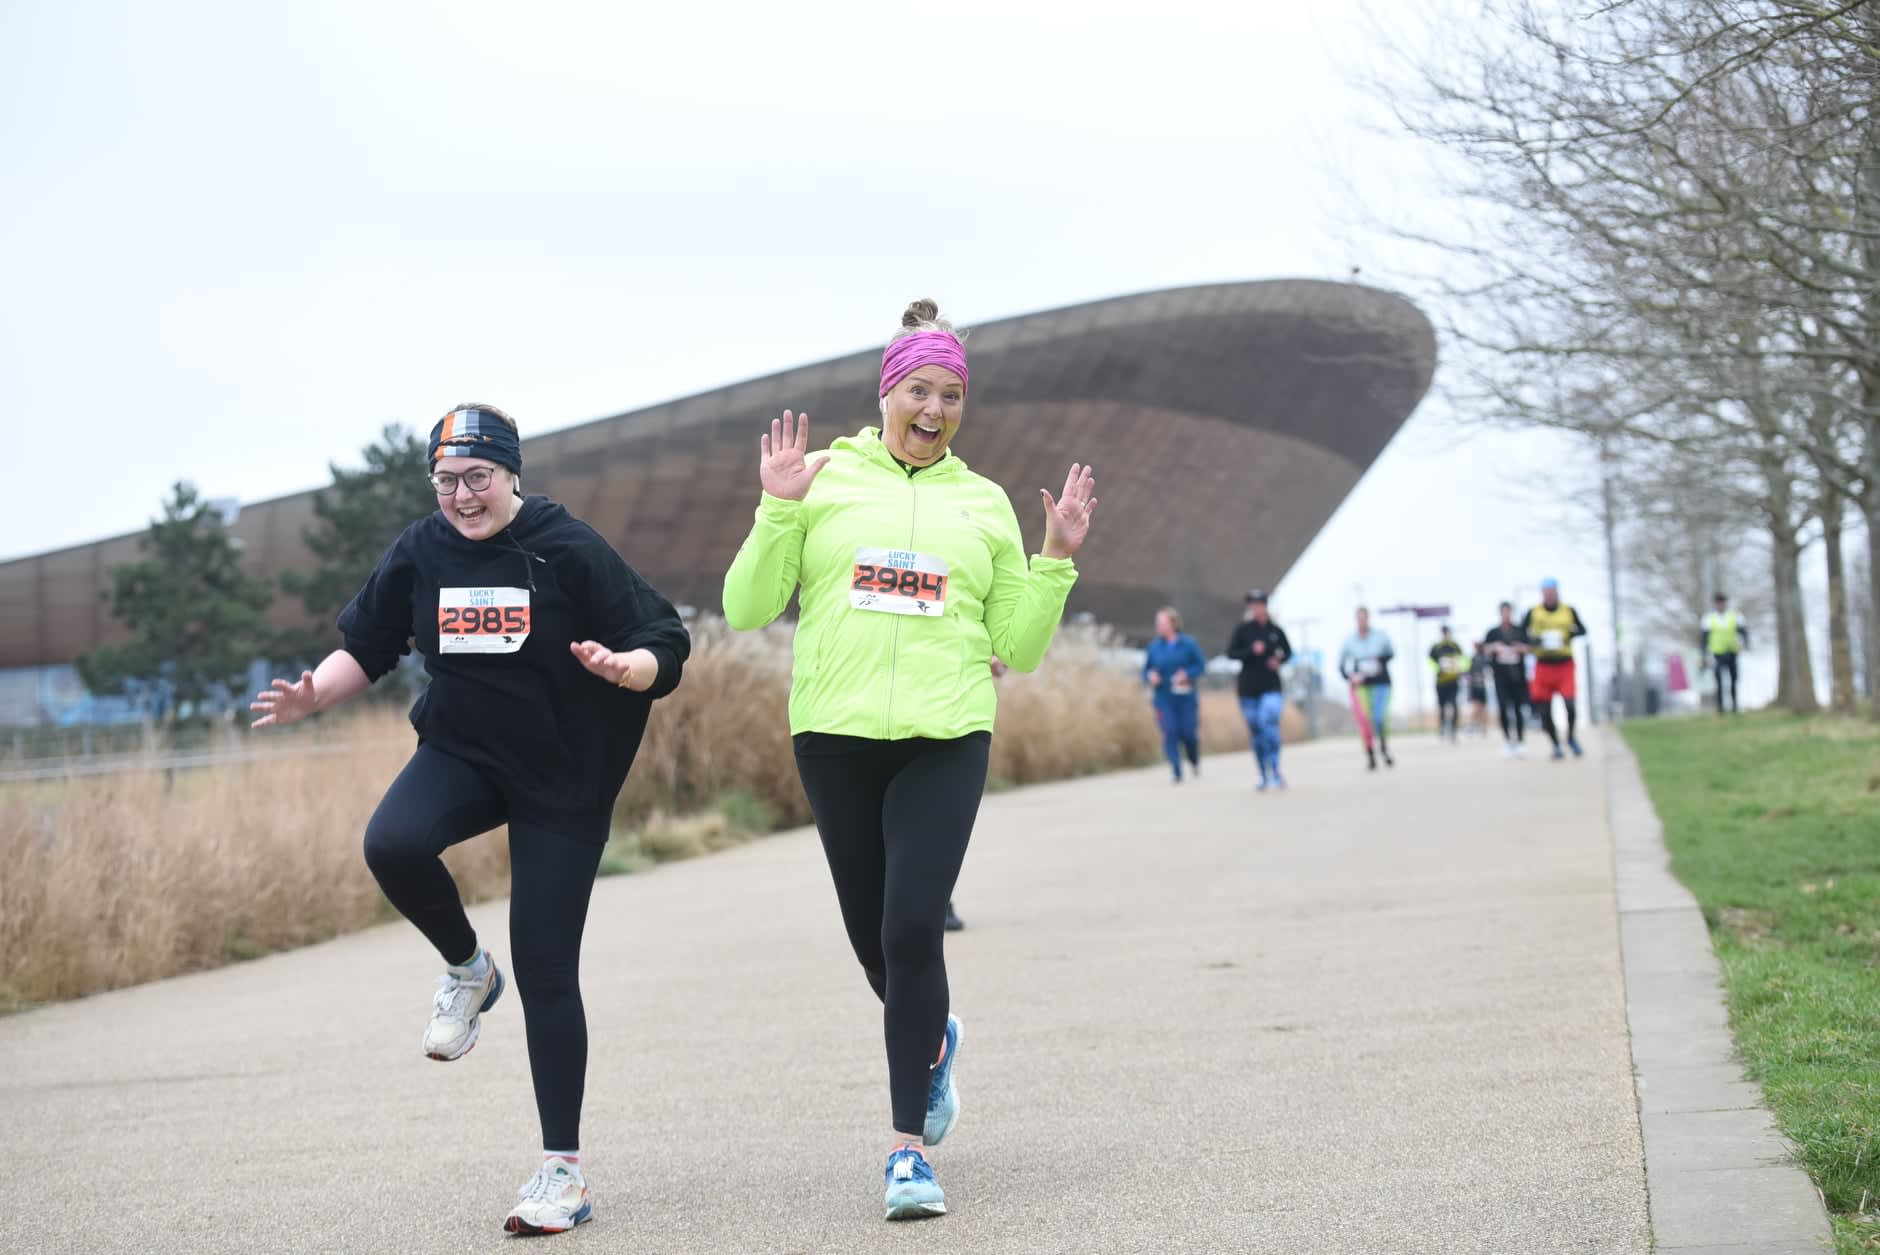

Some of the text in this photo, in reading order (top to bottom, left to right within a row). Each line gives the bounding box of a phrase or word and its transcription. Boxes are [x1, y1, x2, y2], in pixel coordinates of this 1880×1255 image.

[888, 551, 917, 561] LUCKY
[887, 559, 916, 569] SAINT
[854, 565, 943, 600] 2984
[469, 590, 495, 598] LUCKY
[470, 598, 495, 606] SAINT
[442, 607, 526, 633] 2985
